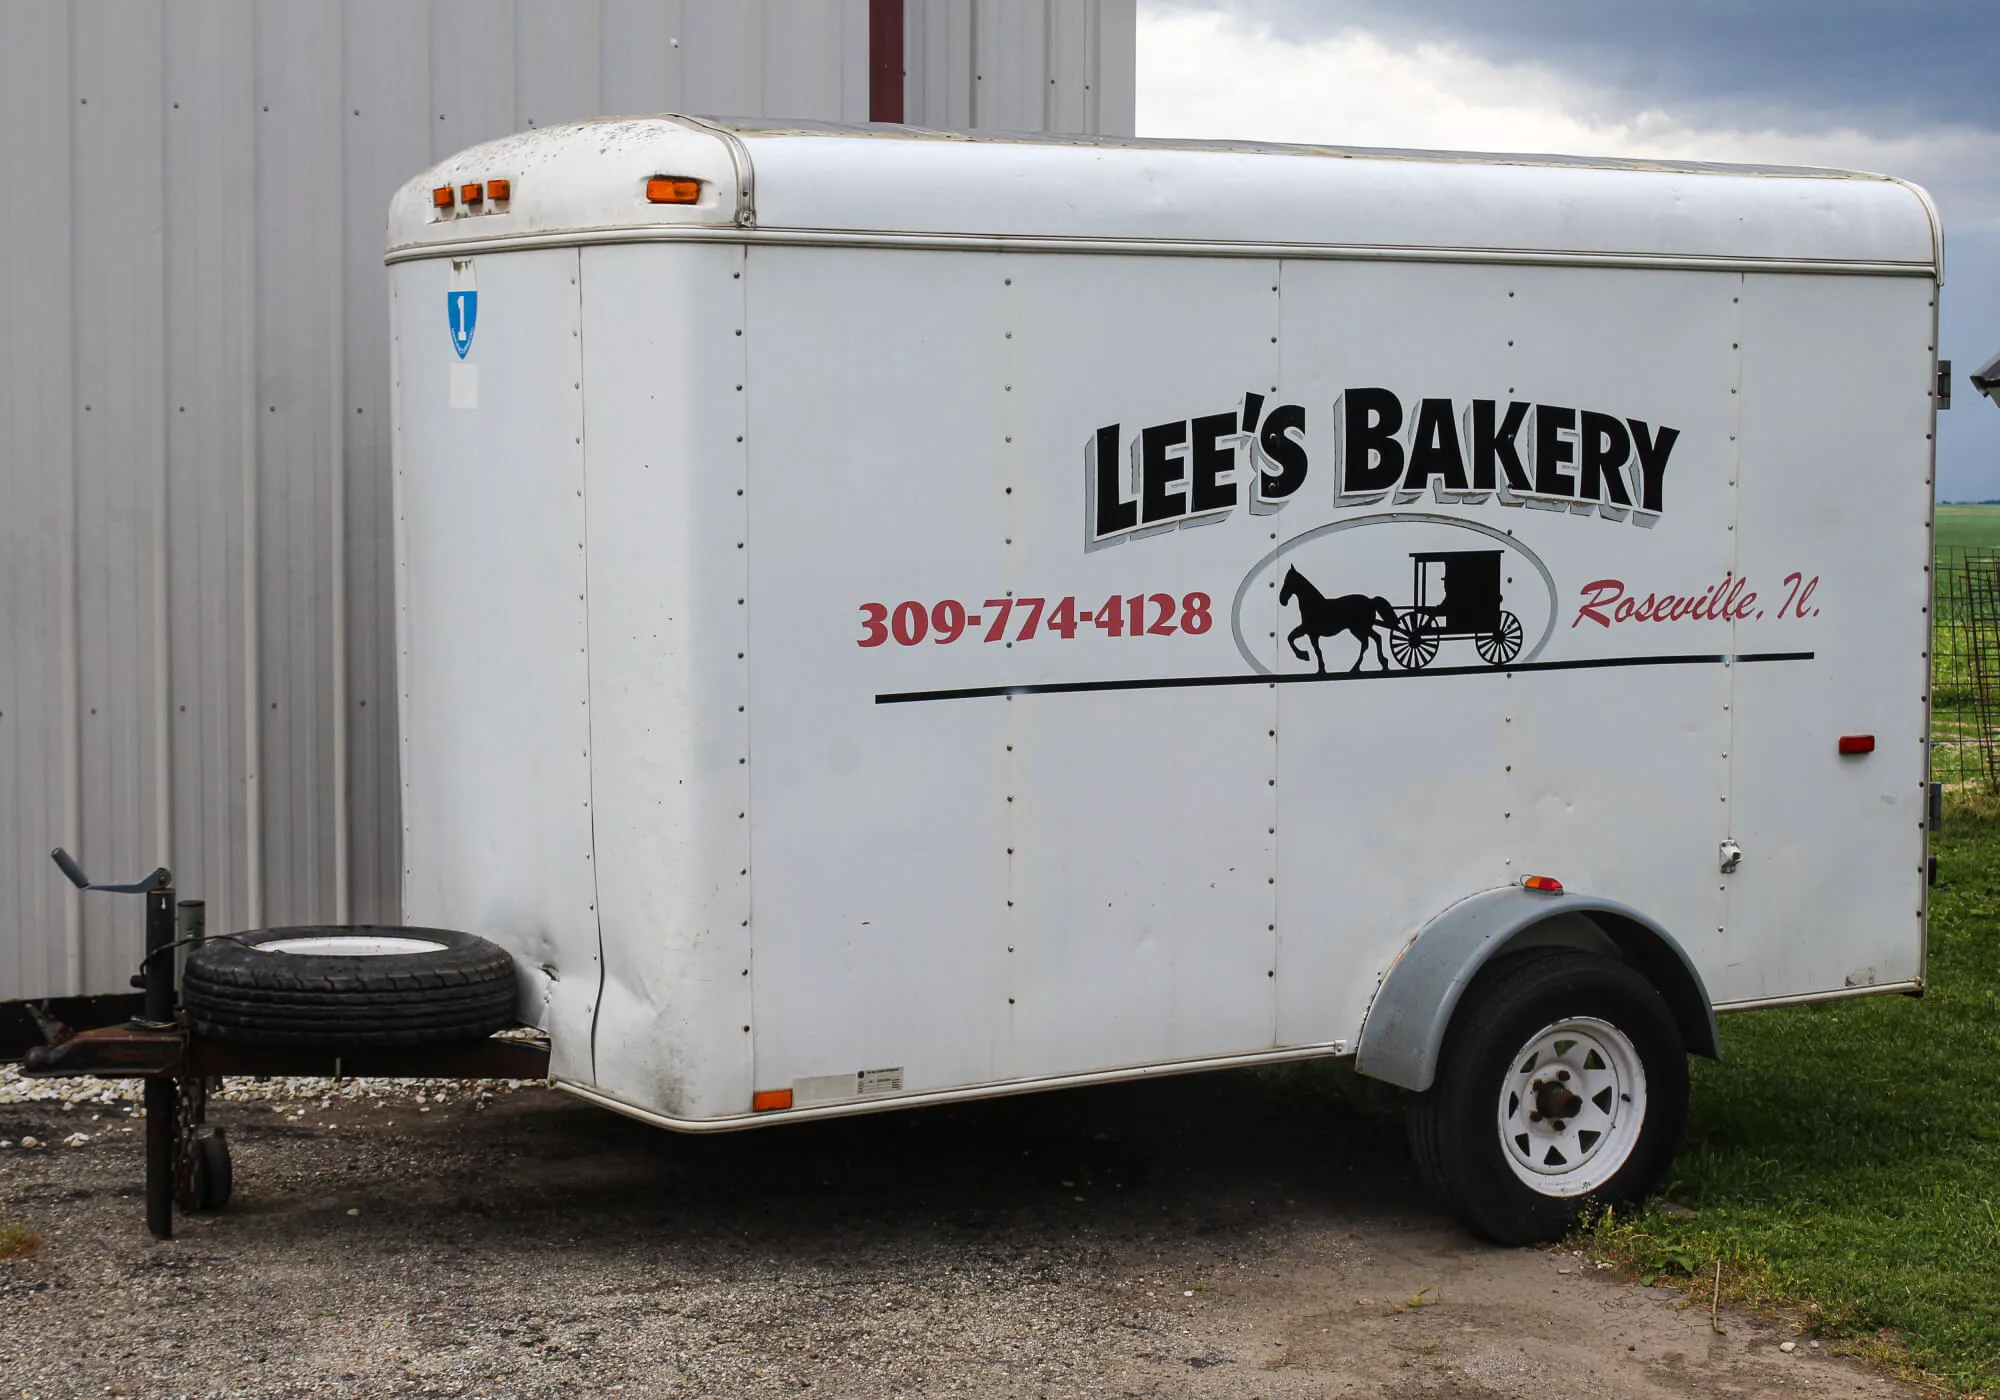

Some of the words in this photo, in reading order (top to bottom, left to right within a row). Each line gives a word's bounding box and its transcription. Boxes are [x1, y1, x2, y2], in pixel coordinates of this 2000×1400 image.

[1092, 389, 1309, 541] LEE'S
[1337, 386, 1681, 515] BAKERY
[857, 591, 1214, 648] 309-774-4128
[1571, 576, 1765, 629] Roseville,
